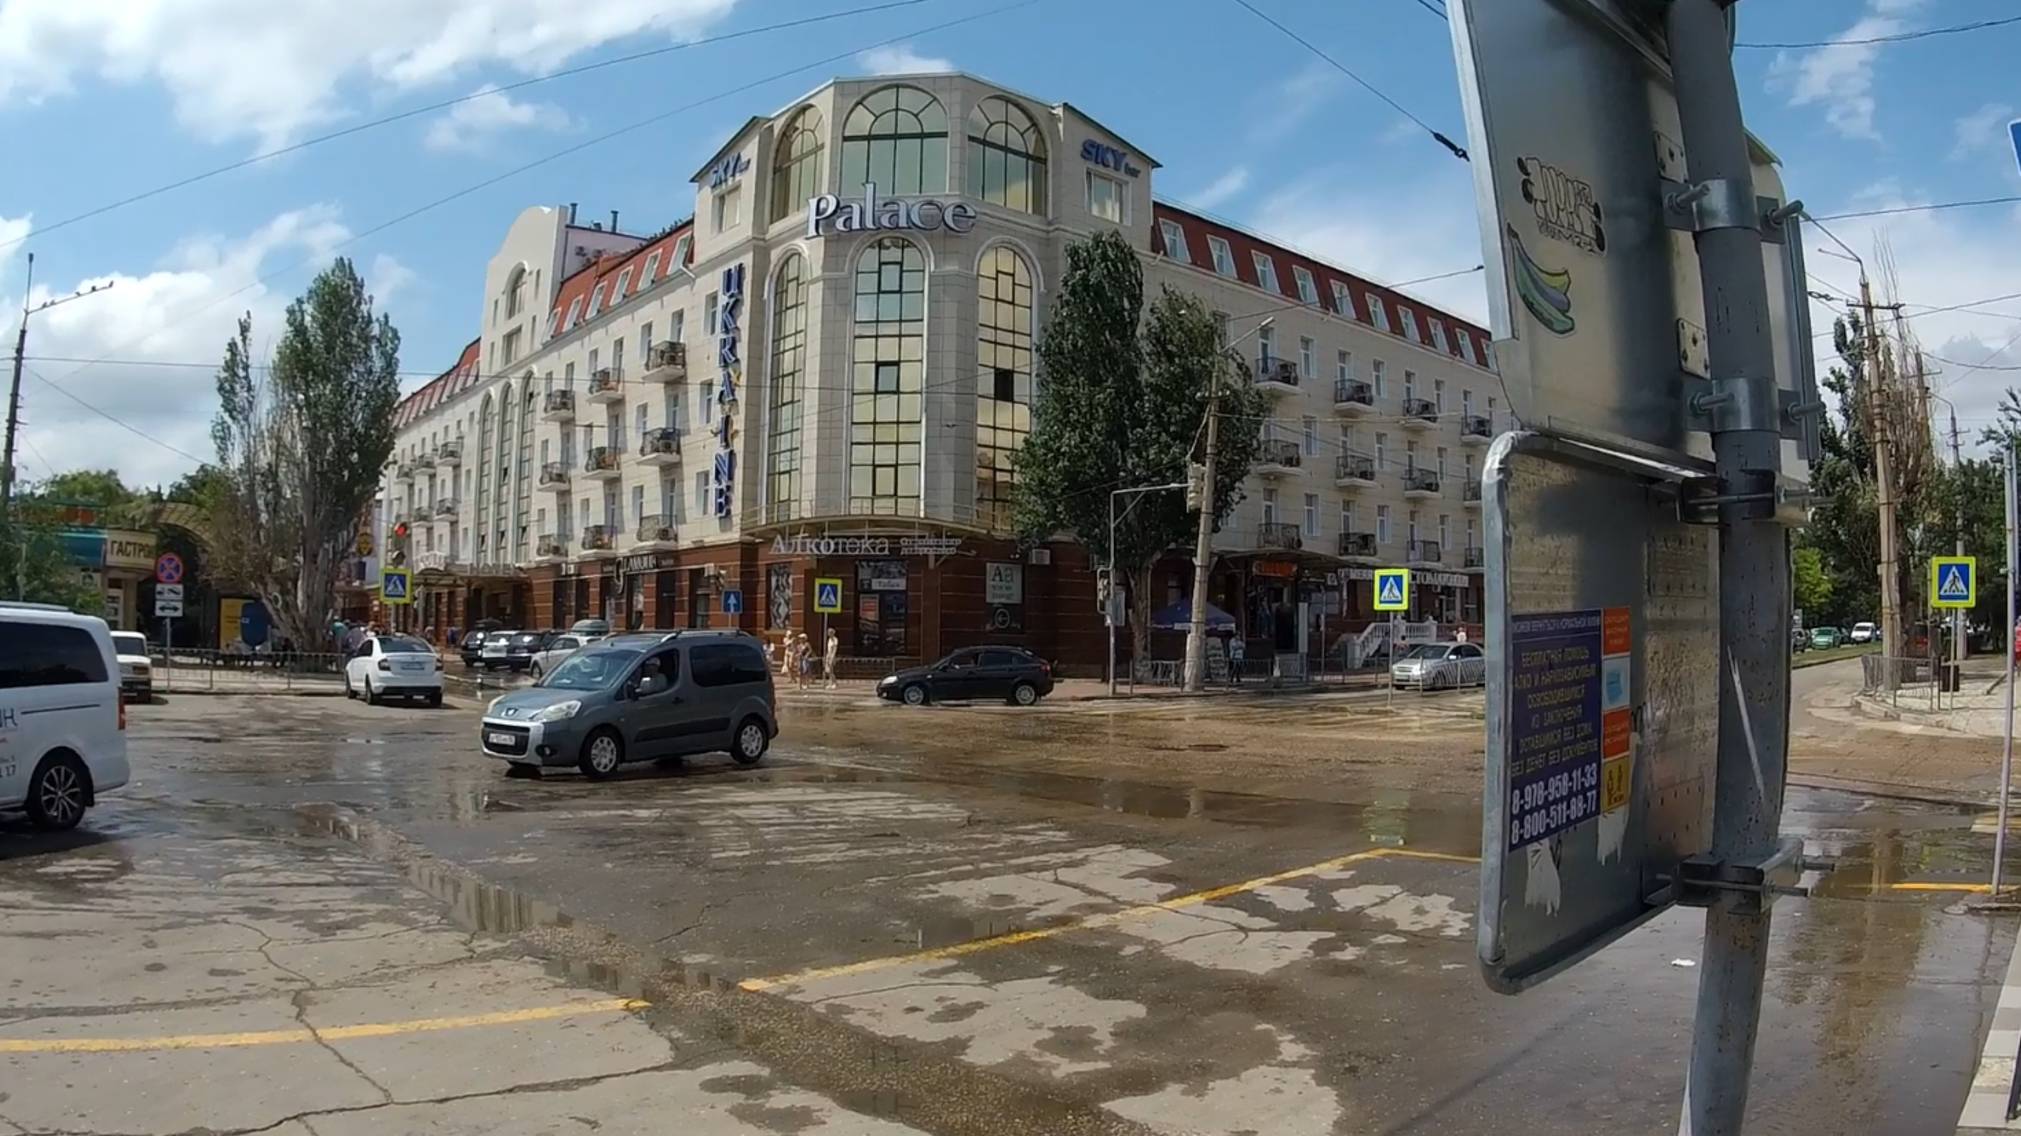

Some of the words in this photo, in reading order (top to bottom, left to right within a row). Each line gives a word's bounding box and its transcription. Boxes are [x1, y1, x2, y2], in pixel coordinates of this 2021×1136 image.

[1081, 139, 1128, 171] SKY
[805, 181, 978, 240] Palace
[715, 262, 745, 518] UKRAINE
[1511, 762, 1597, 815] 8-978-958-11-33
[1511, 788, 1596, 846] 8-800-511-88-77
